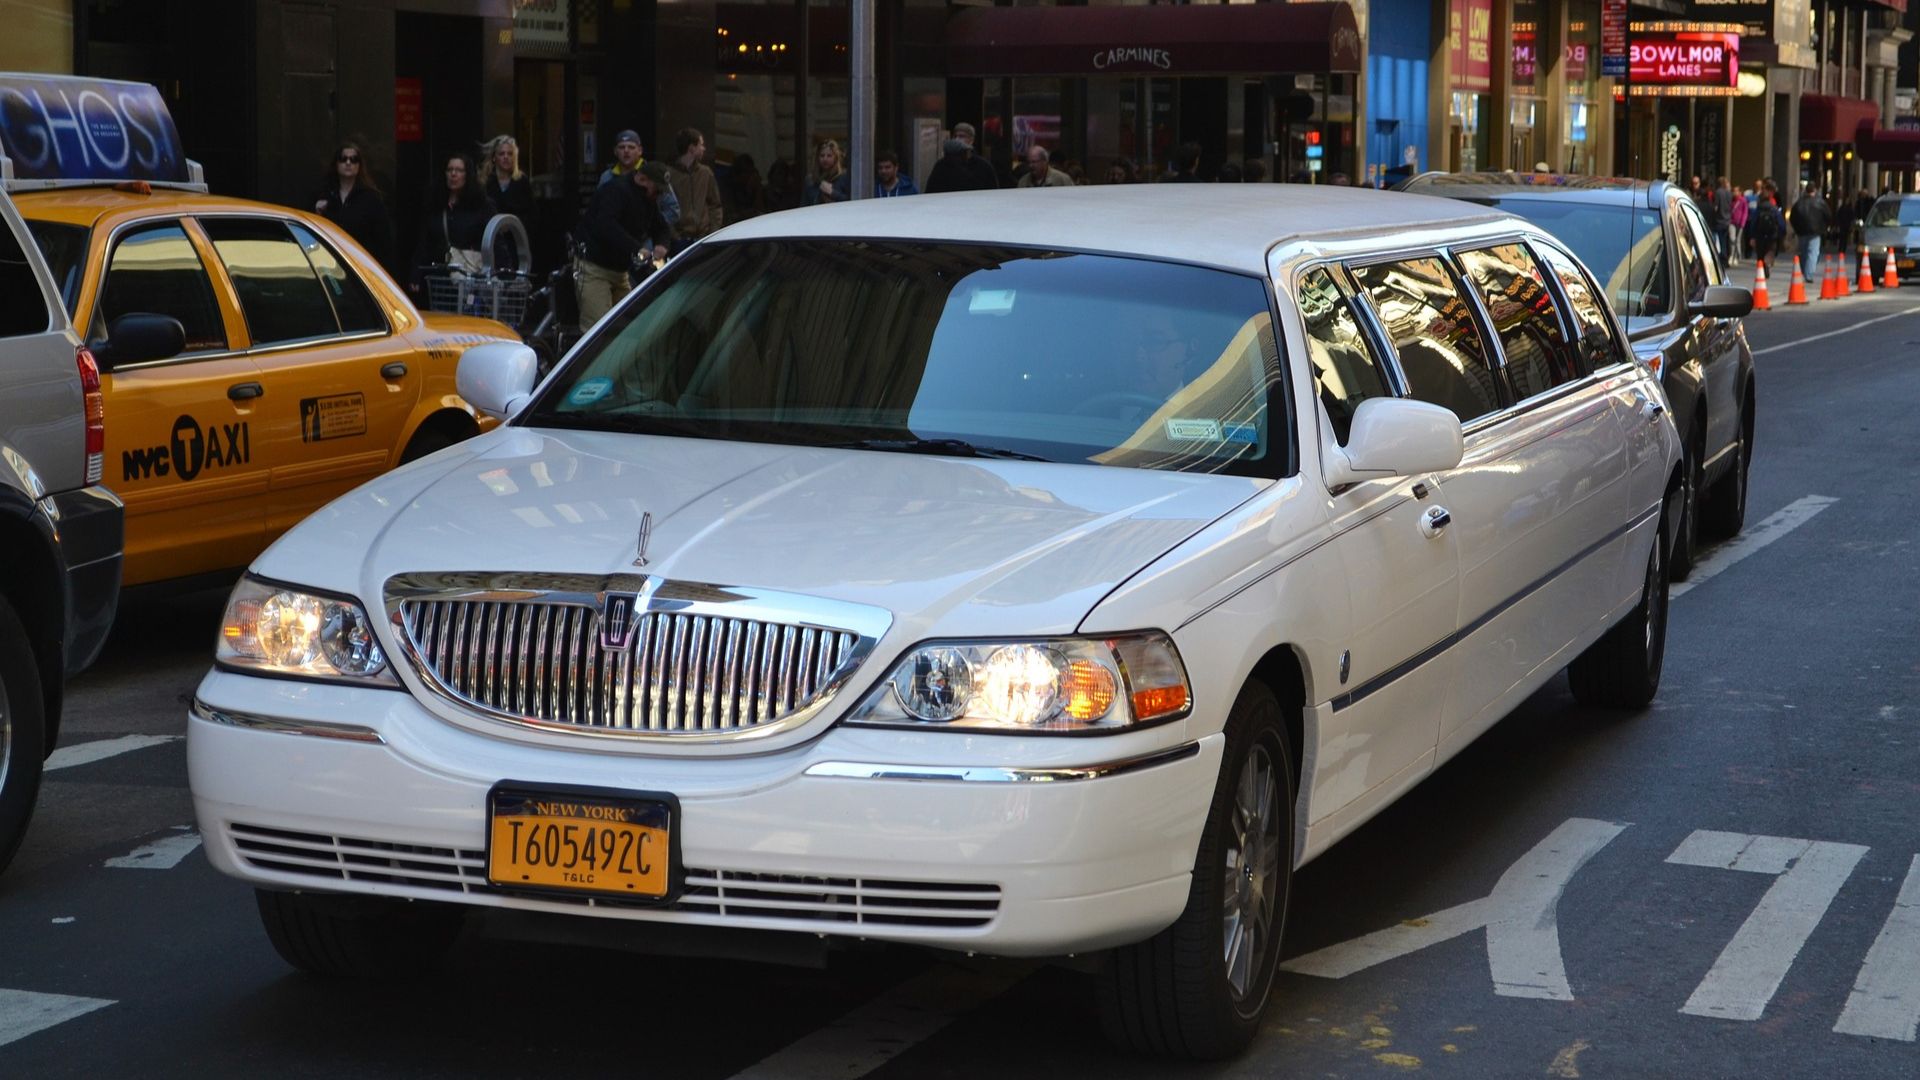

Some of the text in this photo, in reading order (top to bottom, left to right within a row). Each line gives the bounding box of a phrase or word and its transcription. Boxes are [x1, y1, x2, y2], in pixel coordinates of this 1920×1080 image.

[1468, 7, 1490, 41] LOW
[1093, 47, 1171, 69] CARMINES
[1629, 45, 1722, 63] BOWLMOR
[1658, 64, 1701, 77] LANES
[0, 86, 178, 171] GHOST
[122, 418, 250, 482] NYC TAXI
[536, 801, 627, 822] NEW YORK
[508, 821, 652, 876] T605492C
[563, 872, 595, 884] T&LC
